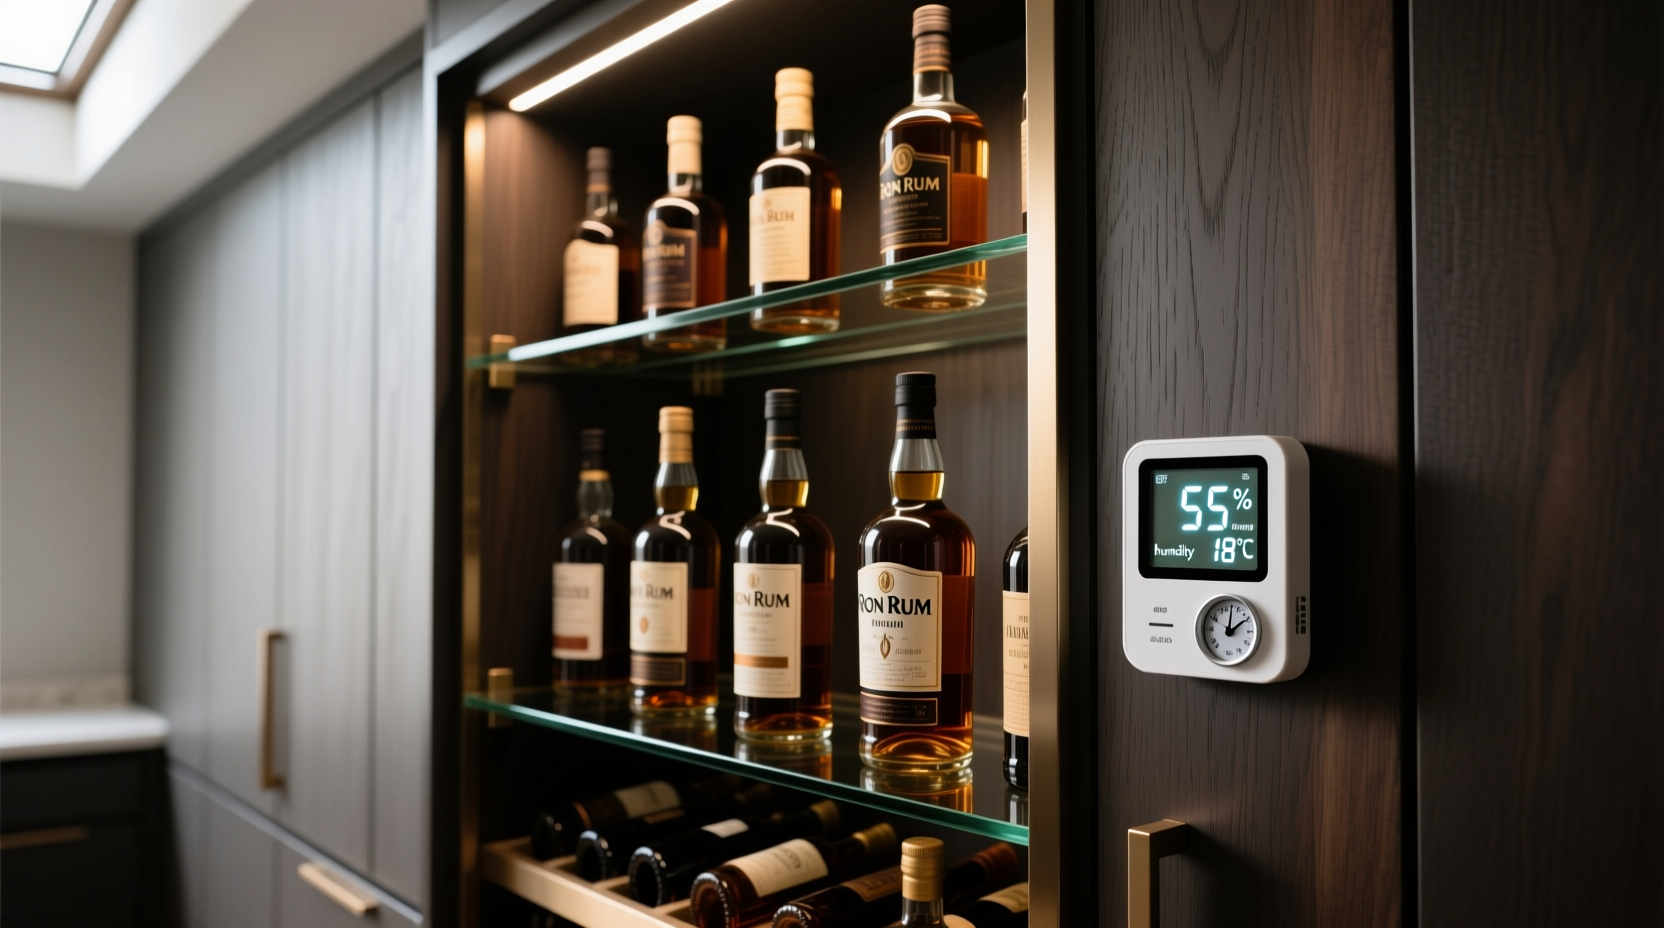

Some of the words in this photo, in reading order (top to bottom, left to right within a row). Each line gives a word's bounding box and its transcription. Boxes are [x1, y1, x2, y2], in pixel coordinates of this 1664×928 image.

[904, 177, 940, 193] RUM
[754, 591, 790, 608] RUM
[887, 595, 932, 616] RUM
